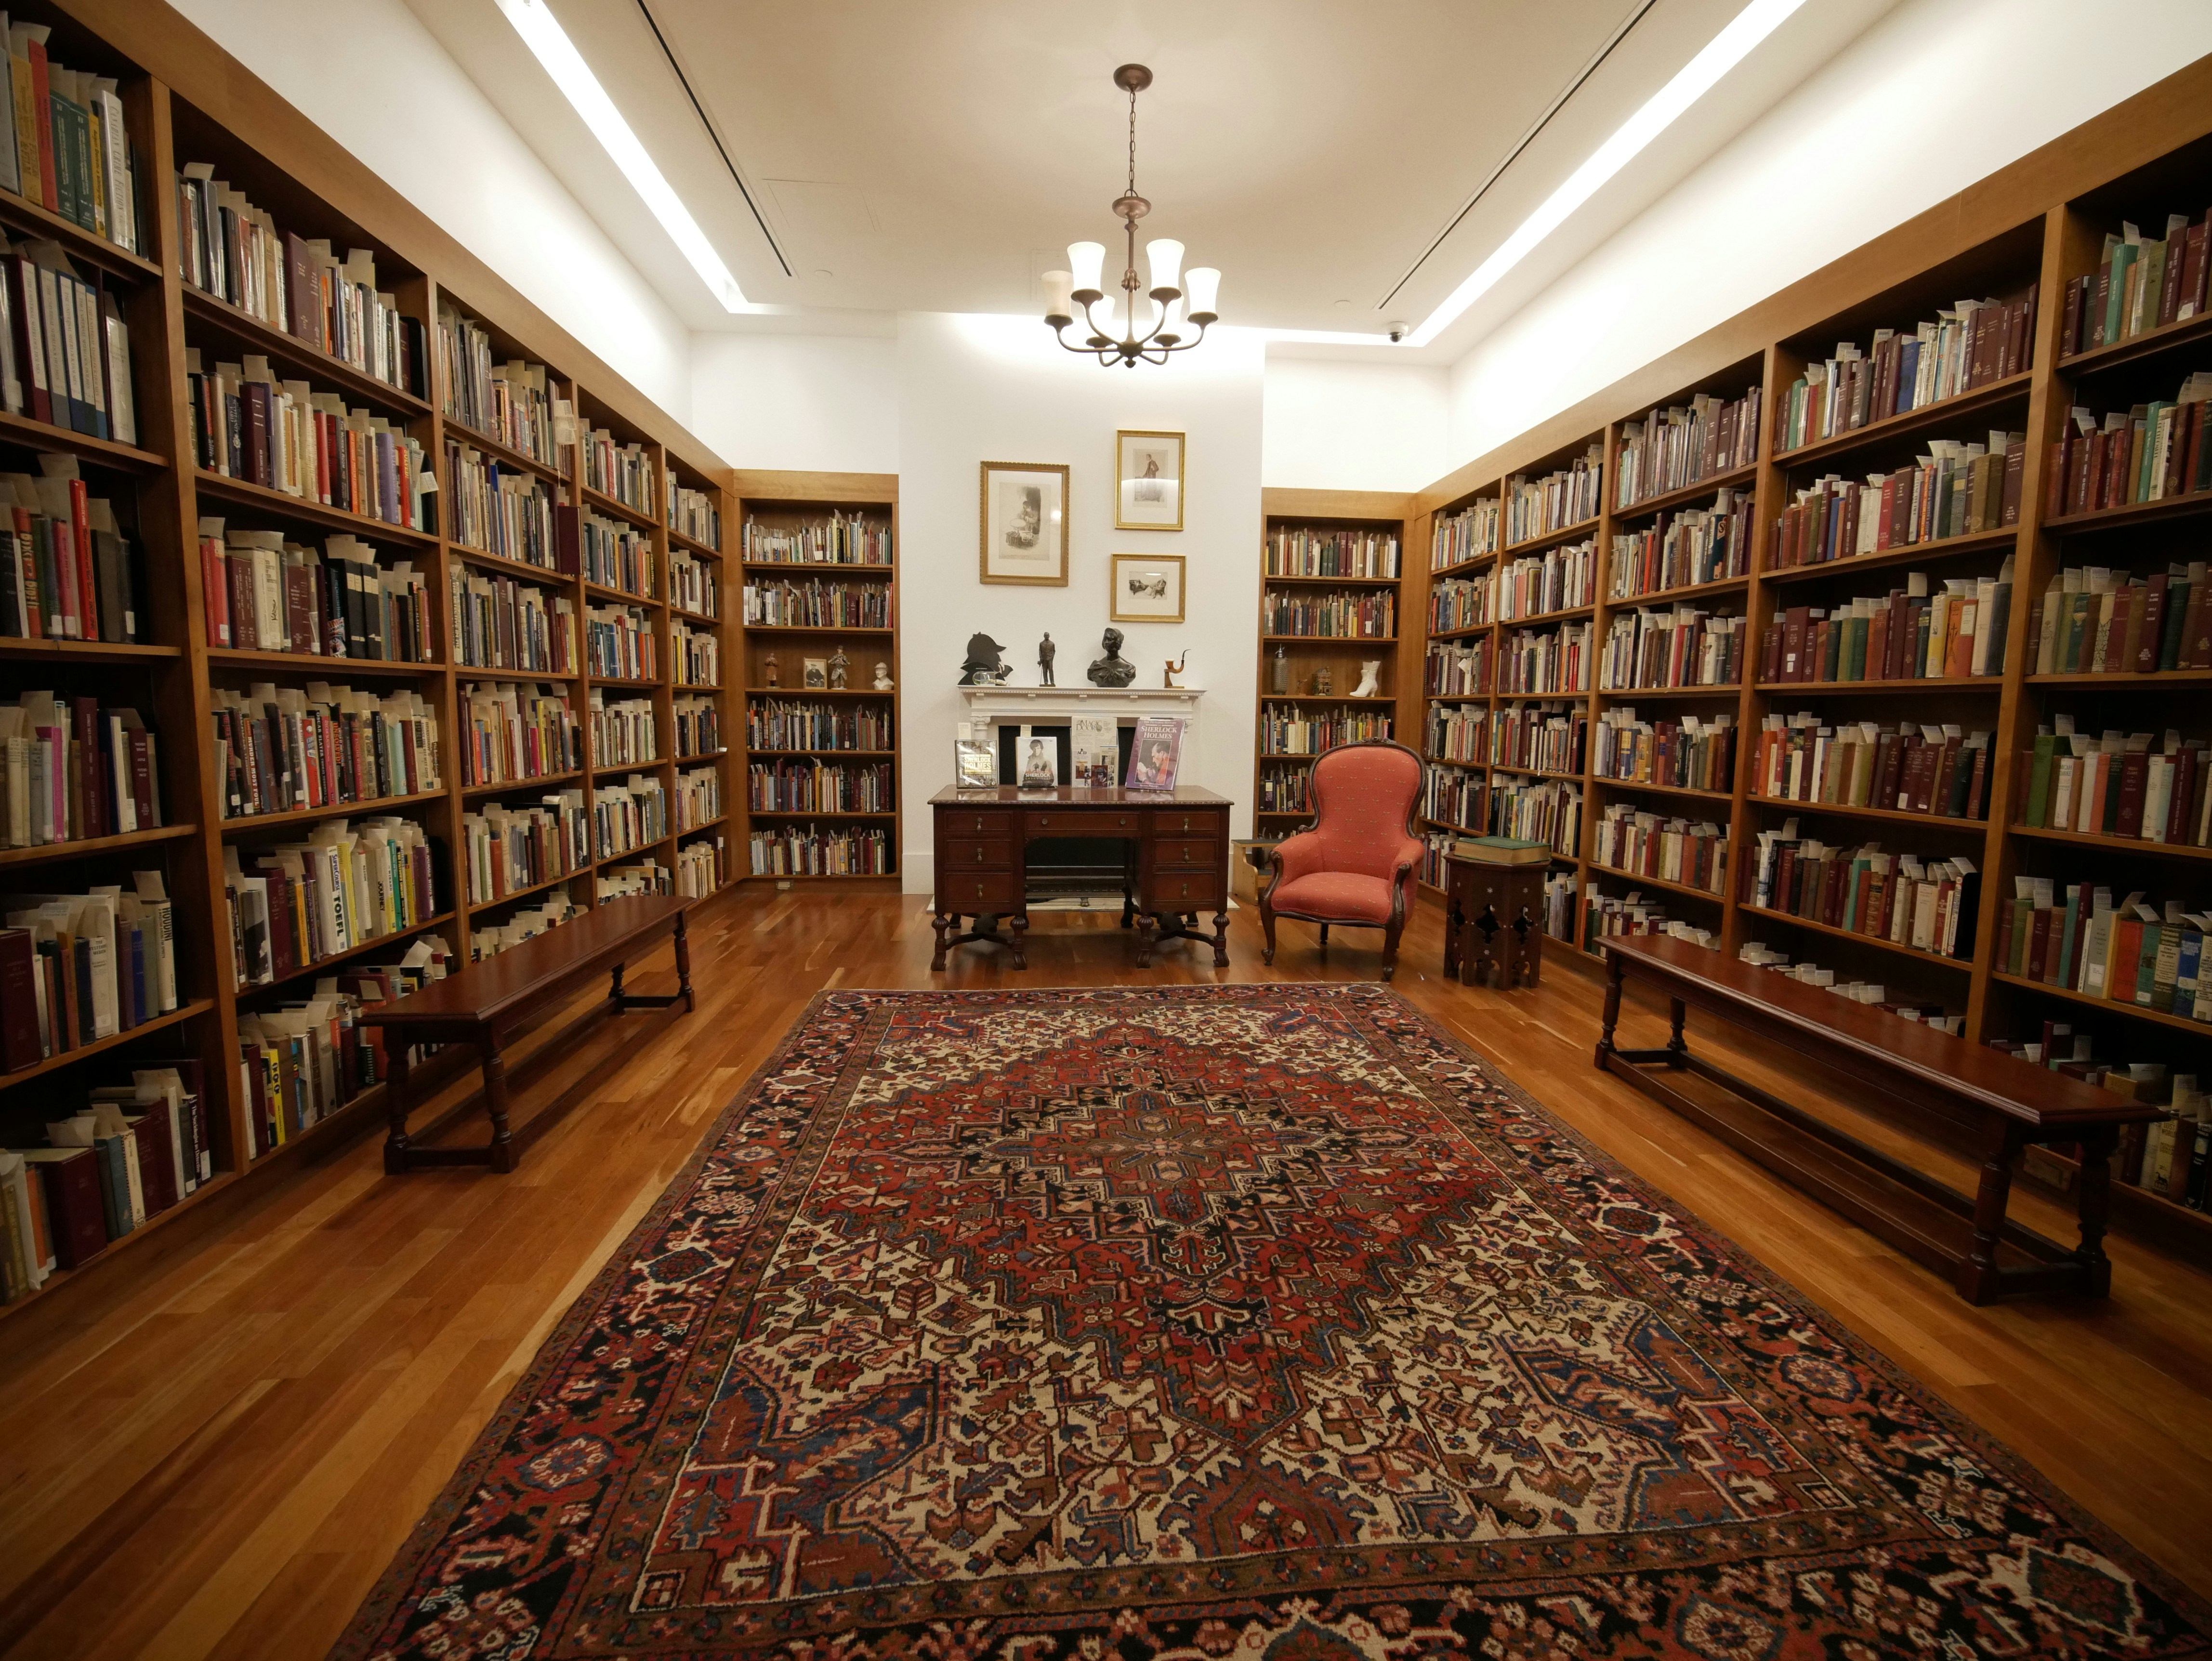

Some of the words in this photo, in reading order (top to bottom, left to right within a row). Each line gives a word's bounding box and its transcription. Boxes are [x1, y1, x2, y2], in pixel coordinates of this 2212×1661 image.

[110, 106, 119, 145] CANADIAN
[113, 151, 122, 175] CRIME
[115, 179, 124, 210] FICTION
[162, 908, 172, 941] HOUDINI
[334, 896, 344, 936] TOEFL
[2161, 1129, 2176, 1138] WORLD
